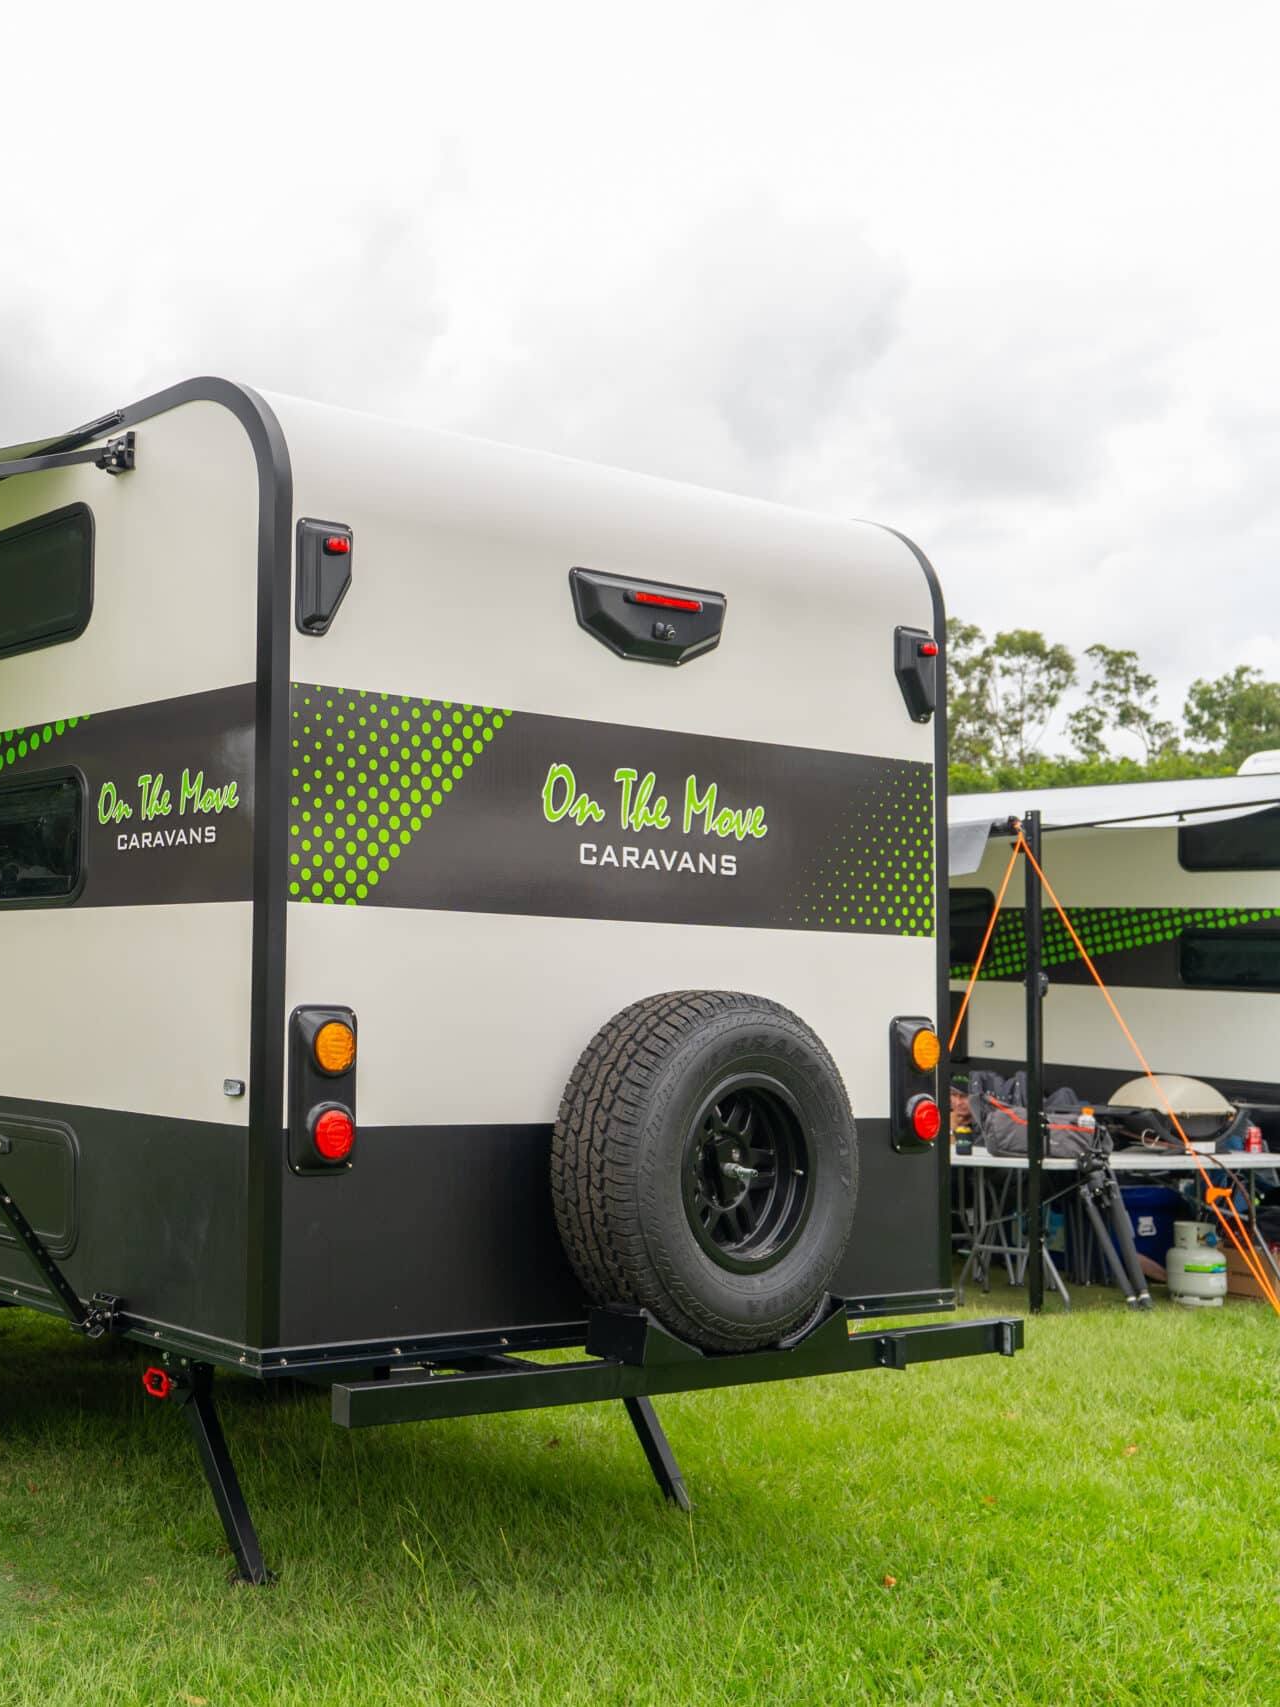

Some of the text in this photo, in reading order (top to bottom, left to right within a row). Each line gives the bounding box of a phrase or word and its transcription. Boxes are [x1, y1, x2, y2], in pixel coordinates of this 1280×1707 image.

[98, 768, 239, 824] On The Move
[542, 763, 768, 840] On The Move
[117, 826, 217, 850] CARAVANS
[579, 842, 737, 876] CARAVANS
